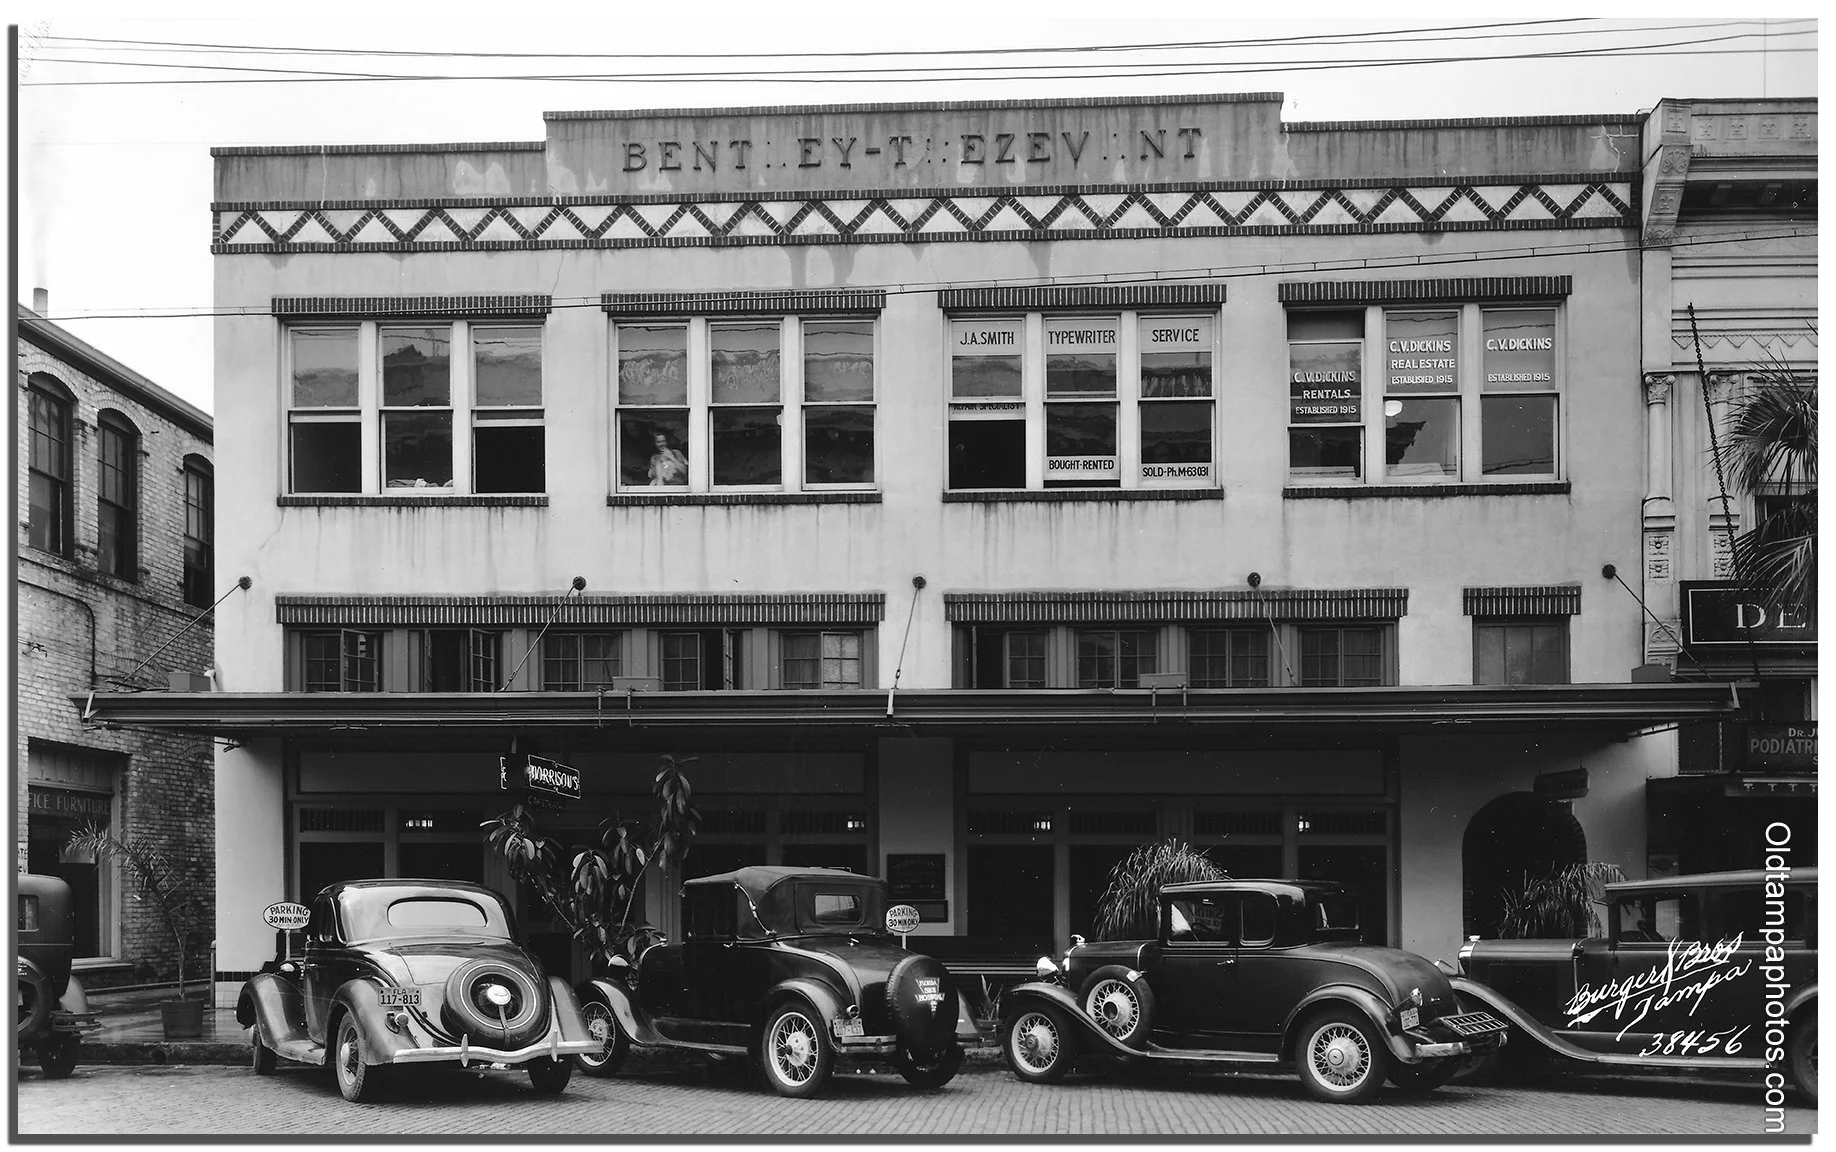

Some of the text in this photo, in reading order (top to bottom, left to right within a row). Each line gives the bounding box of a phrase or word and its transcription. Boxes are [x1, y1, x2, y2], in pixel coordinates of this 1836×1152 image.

[621, 127, 1202, 173] BENTEY-TEZEVNT
[1048, 329, 1116, 345] TYPEWRITER
[1151, 328, 1200, 343] SERVICE
[1391, 374, 1453, 384] ESTABLISHED 1915
[1487, 372, 1551, 382] ESTABLISHED 1915
[1303, 389, 1351, 399] RENTALS
[1295, 405, 1357, 414] ESTABLISHED 1915
[56, 794, 110, 816] FURNITURE
[270, 905, 309, 916] PARKING
[889, 908, 917, 918] PARKING
[380, 994, 420, 1005] 117-813
